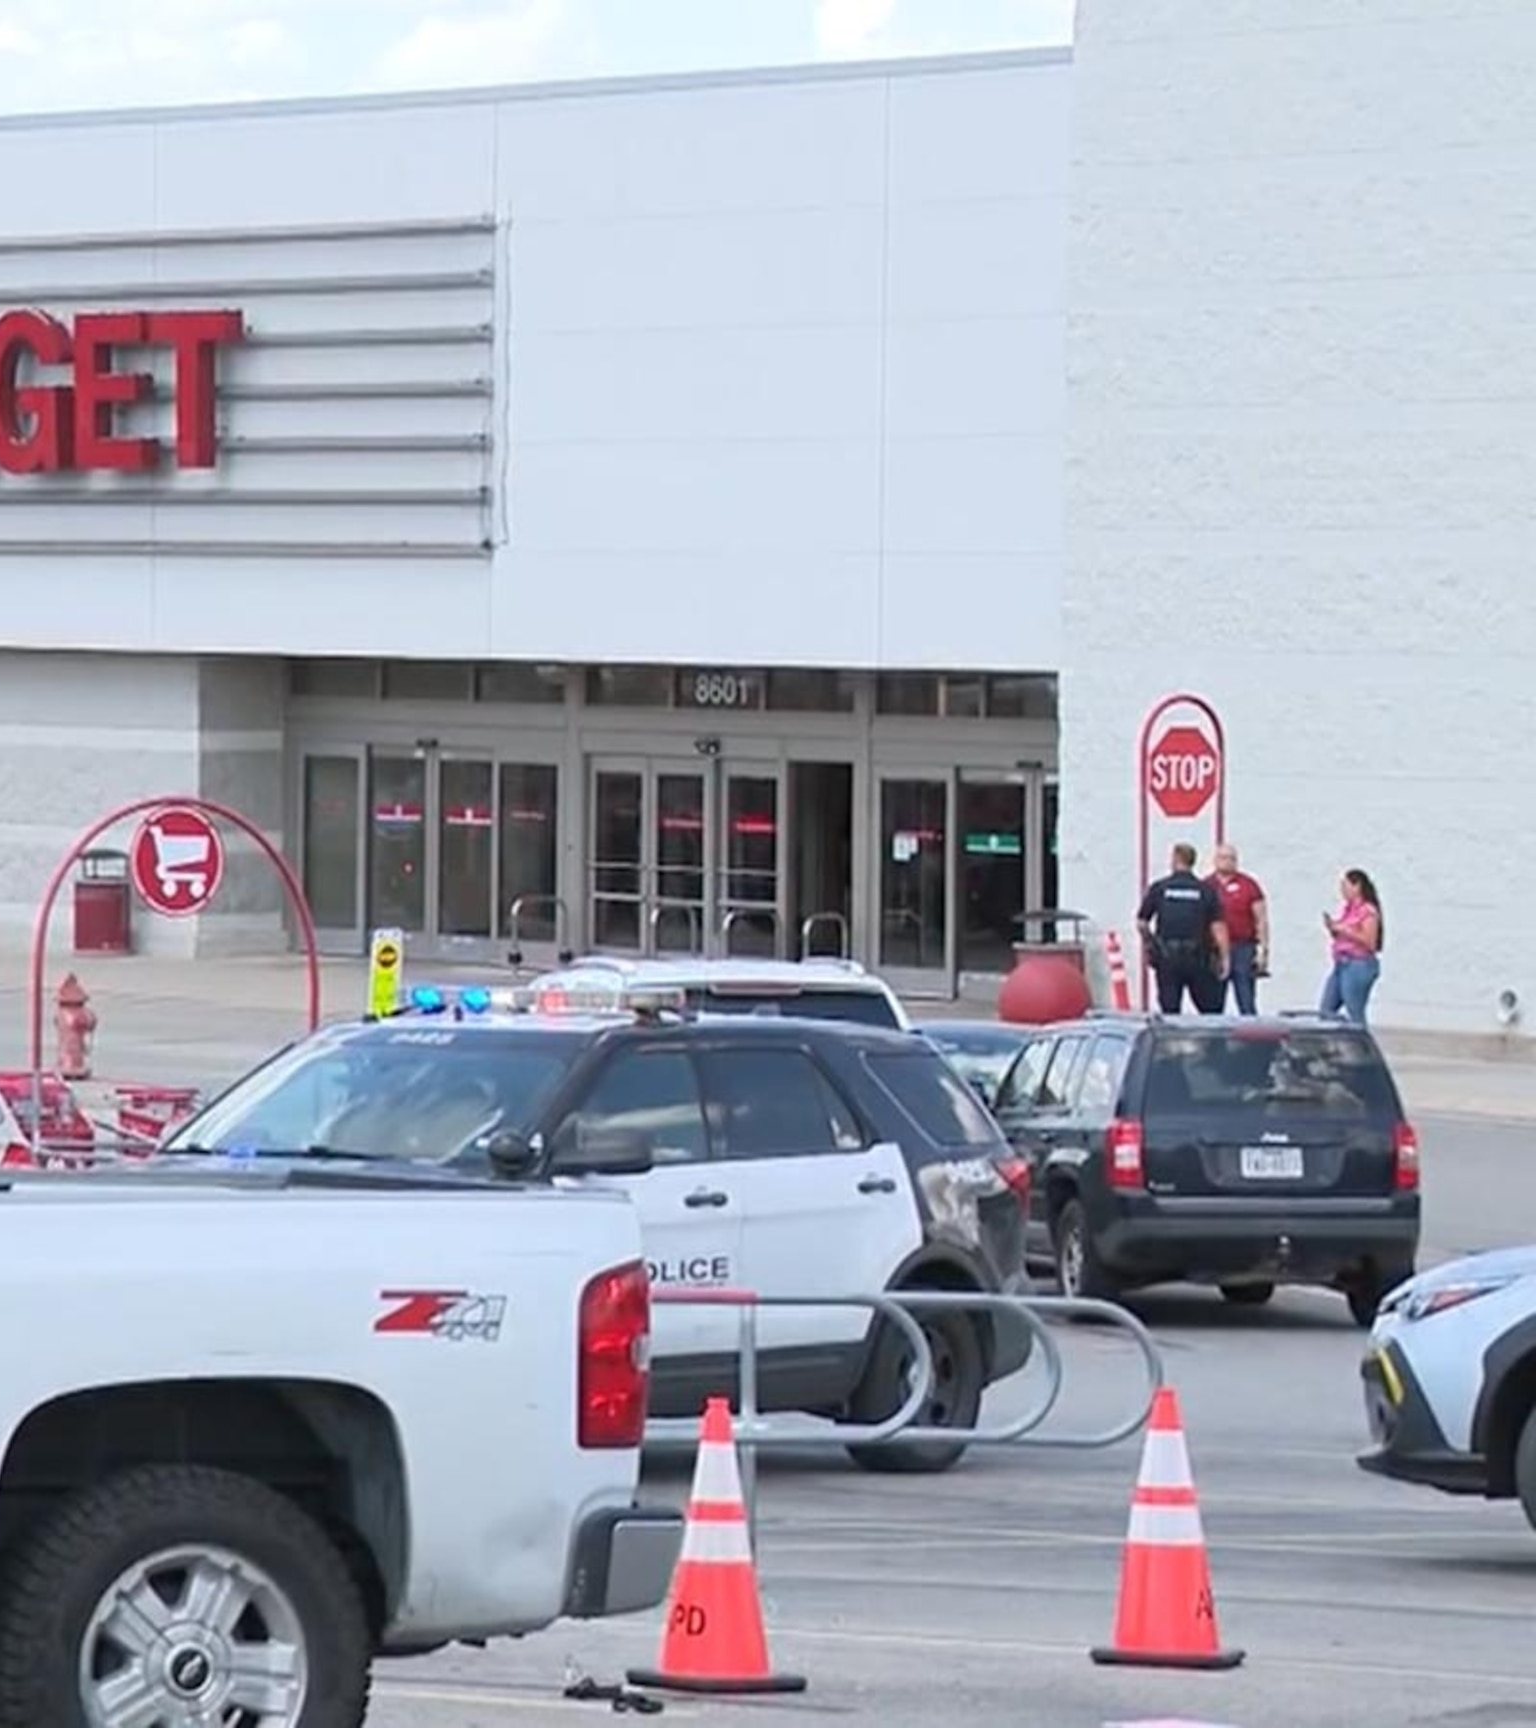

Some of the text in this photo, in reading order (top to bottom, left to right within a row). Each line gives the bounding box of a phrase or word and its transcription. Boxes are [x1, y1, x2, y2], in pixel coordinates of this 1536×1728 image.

[695, 674, 747, 704] 8601
[1152, 754, 1214, 790] STOP
[647, 1256, 730, 1281] OLICE
[670, 1603, 707, 1636] PD
